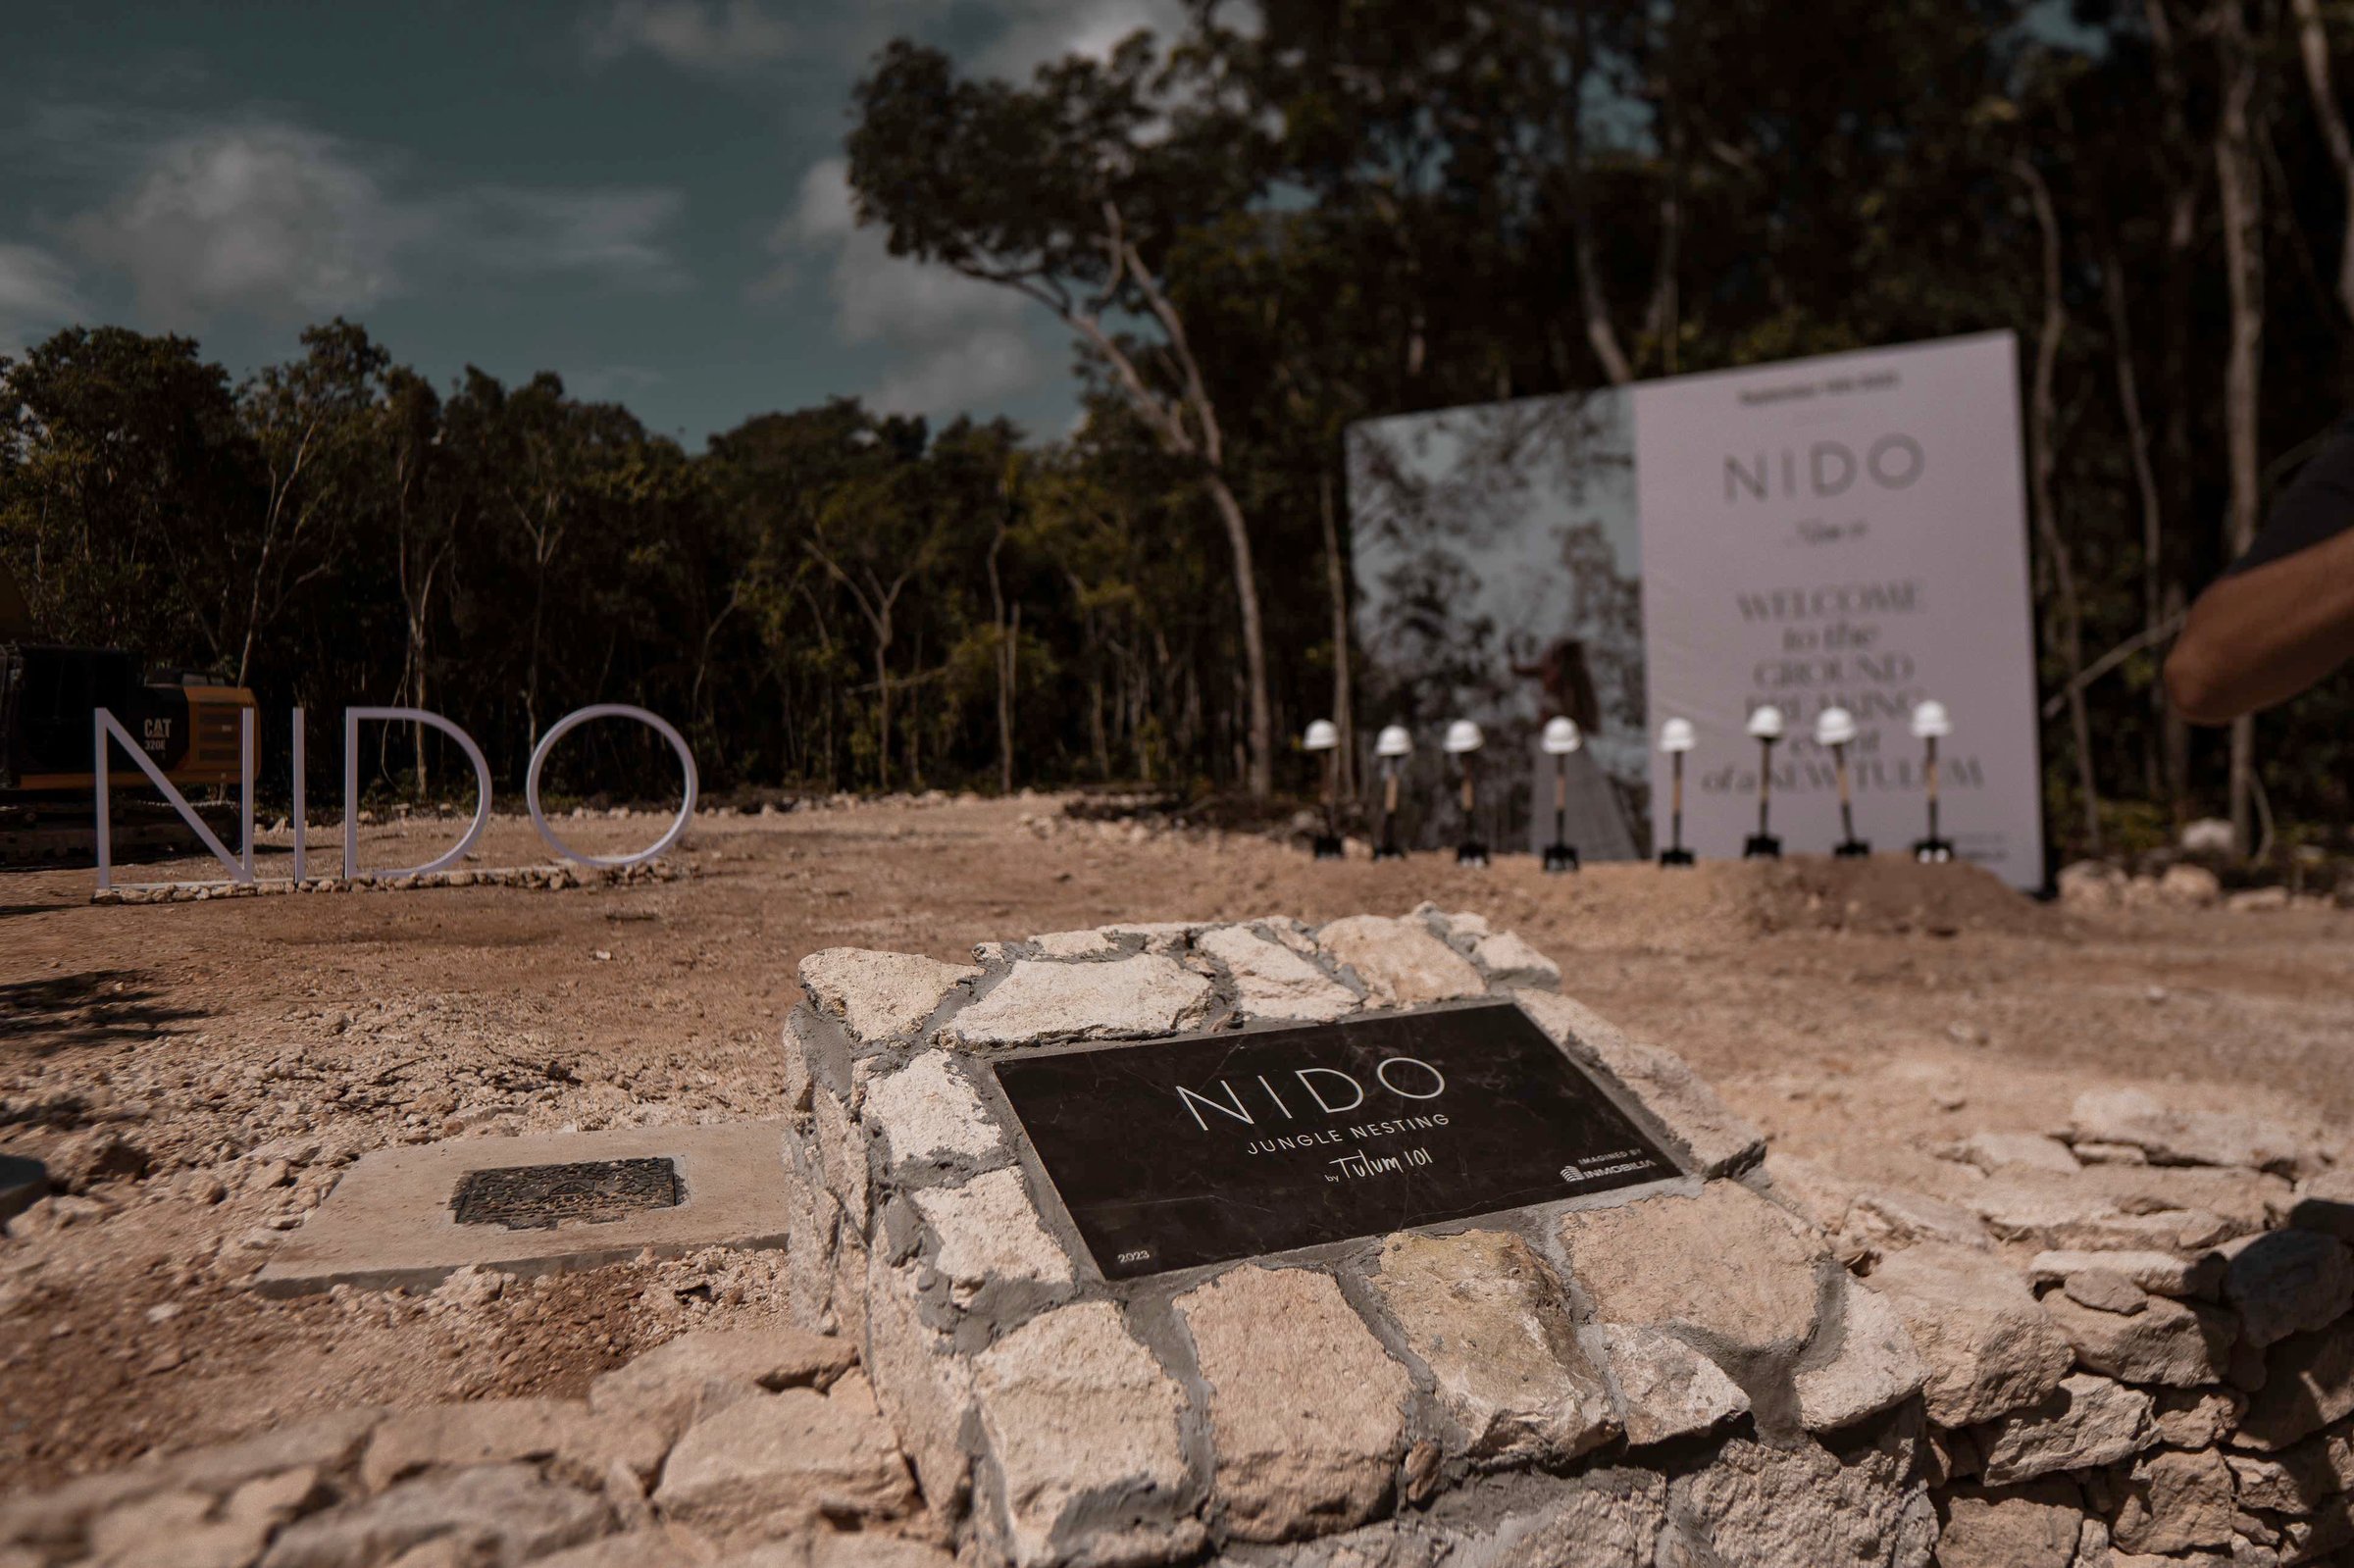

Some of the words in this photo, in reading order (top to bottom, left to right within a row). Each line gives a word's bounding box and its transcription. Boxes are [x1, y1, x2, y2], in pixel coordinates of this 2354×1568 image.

[1722, 432, 1926, 503] NIDO
[144, 718, 172, 738] CAT
[95, 703, 697, 888] NIDO
[1176, 1057, 1446, 1131] NIDO
[1248, 1130, 1343, 1155] JUNGLE
[1350, 1113, 1450, 1138] NESTING
[1329, 1149, 1404, 1178] Tulum
[1404, 1146, 1433, 1166] 101
[1324, 1174, 1340, 1183] by
[1583, 1159, 1658, 1179] INMOBILIA
[1118, 1249, 1151, 1264] 2023
